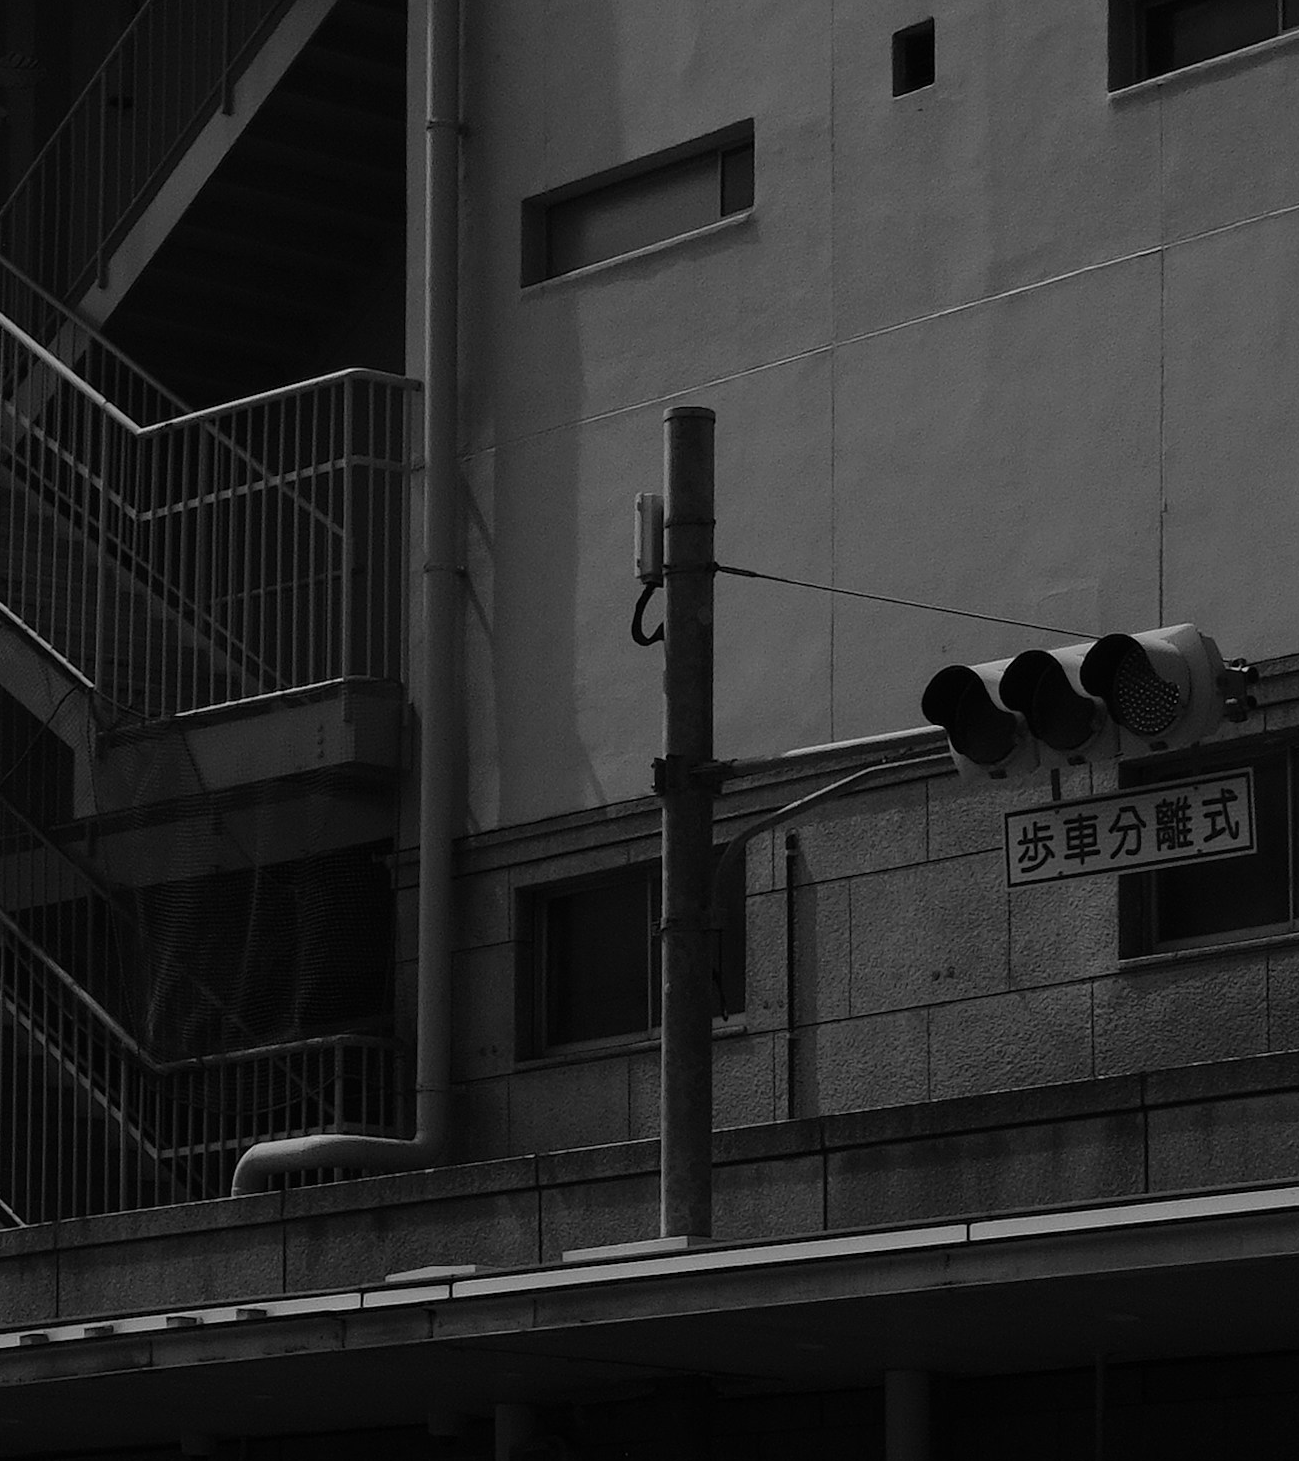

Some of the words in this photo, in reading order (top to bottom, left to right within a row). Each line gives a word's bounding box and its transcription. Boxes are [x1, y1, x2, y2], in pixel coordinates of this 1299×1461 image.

[1017, 787, 1241, 874] 歩車分離式
